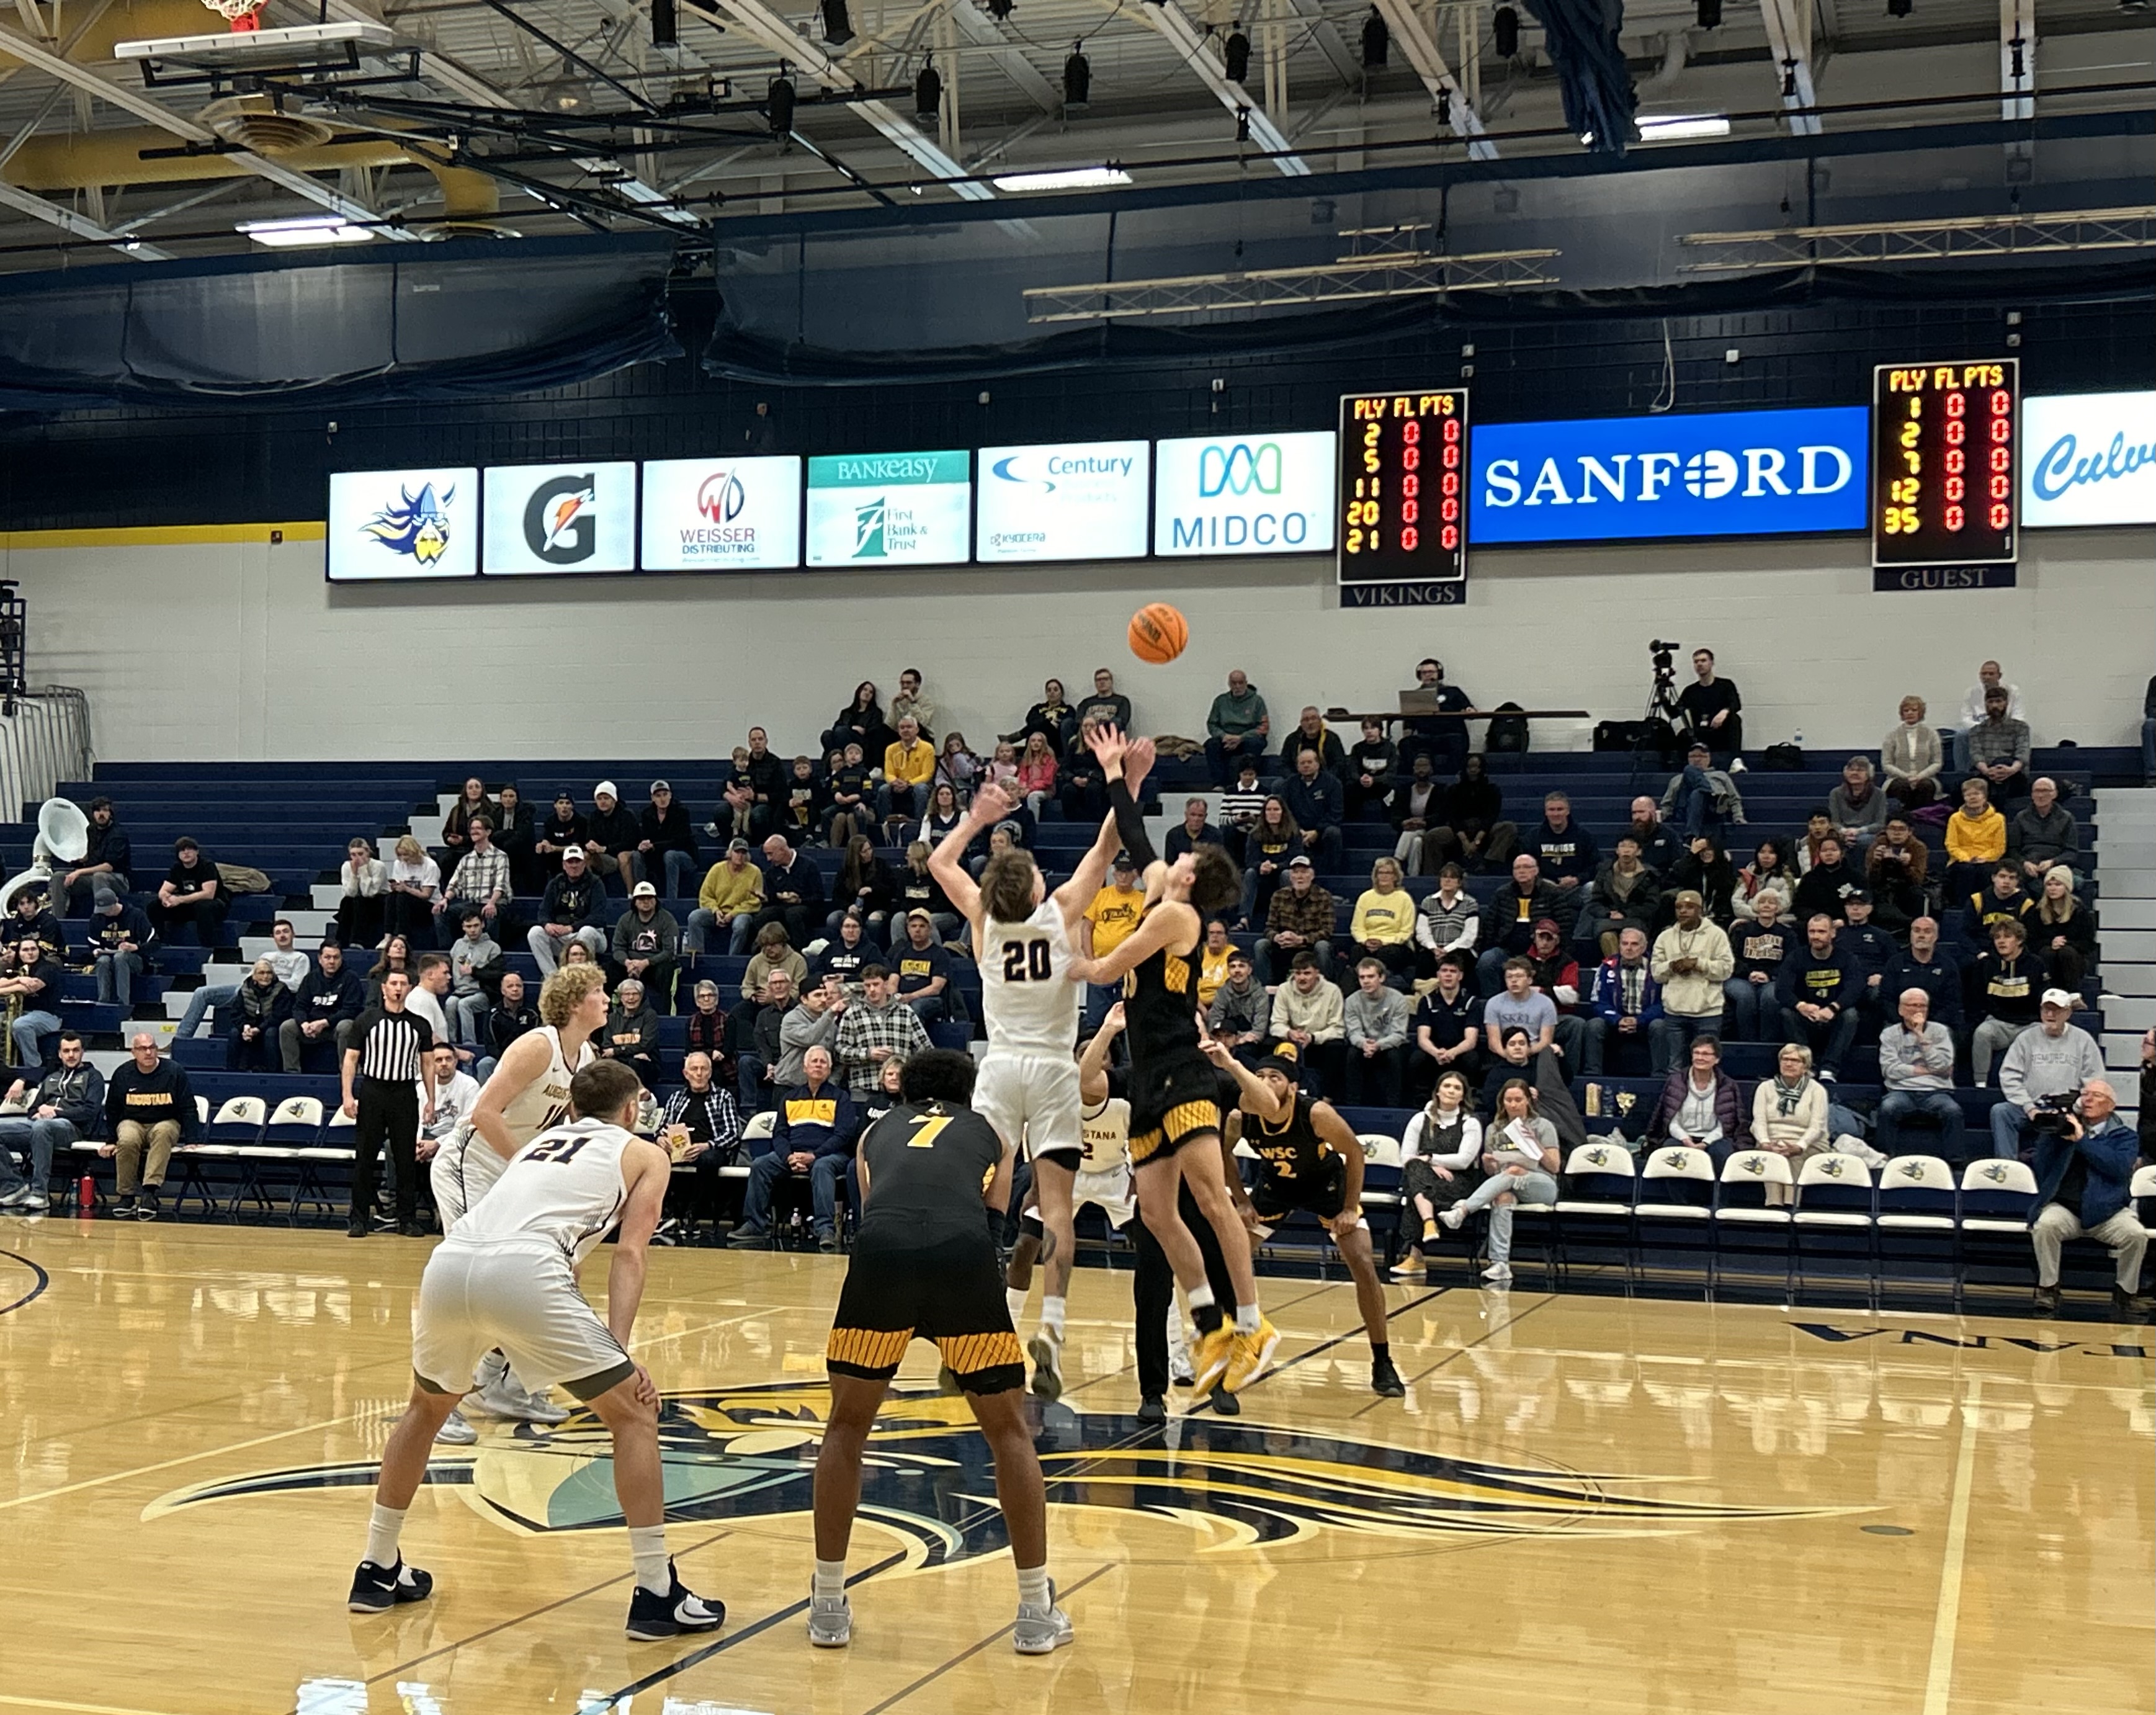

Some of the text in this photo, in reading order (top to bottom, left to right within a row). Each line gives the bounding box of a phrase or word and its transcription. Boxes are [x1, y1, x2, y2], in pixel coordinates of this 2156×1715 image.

[1890, 365, 2004, 392] PLY FL PTS
[1354, 395, 1454, 419] PLY FL PTS
[1946, 392, 1966, 418] 0
[1992, 390, 2010, 416] 0
[1364, 419, 1460, 447] 2 0 0
[1901, 418, 2010, 448] 2 0 0
[838, 458, 938, 483] BANKeasy
[1049, 457, 1133, 477] Century
[1364, 444, 1459, 473] 5 0 0
[1946, 449, 1965, 475] 0
[1990, 447, 2010, 472] 0
[1355, 472, 1459, 498] 11 0 0
[1485, 445, 1852, 507] SANFORD
[1892, 475, 2010, 504] 12 0 0
[524, 473, 596, 564] G
[887, 508, 913, 521] First
[1346, 498, 1458, 526] 20 0 0
[1885, 503, 2010, 534] 35 0 0
[680, 527, 754, 543] WEISSER
[887, 524, 928, 536] Bank &
[887, 538, 916, 550] Trust
[1173, 513, 1306, 548] MIDCO
[1346, 525, 1458, 553] 21 0 0
[682, 544, 754, 554] DISTRIBUTING
[1900, 568, 1989, 589] GUEST
[1353, 585, 1456, 604] VIKINGS
[1003, 939, 1052, 982] 20
[907, 1115, 954, 1148] 7
[519, 1137, 593, 1165] 21
[1258, 1147, 1297, 1159] WSC
[1273, 1161, 1297, 1178] 2
